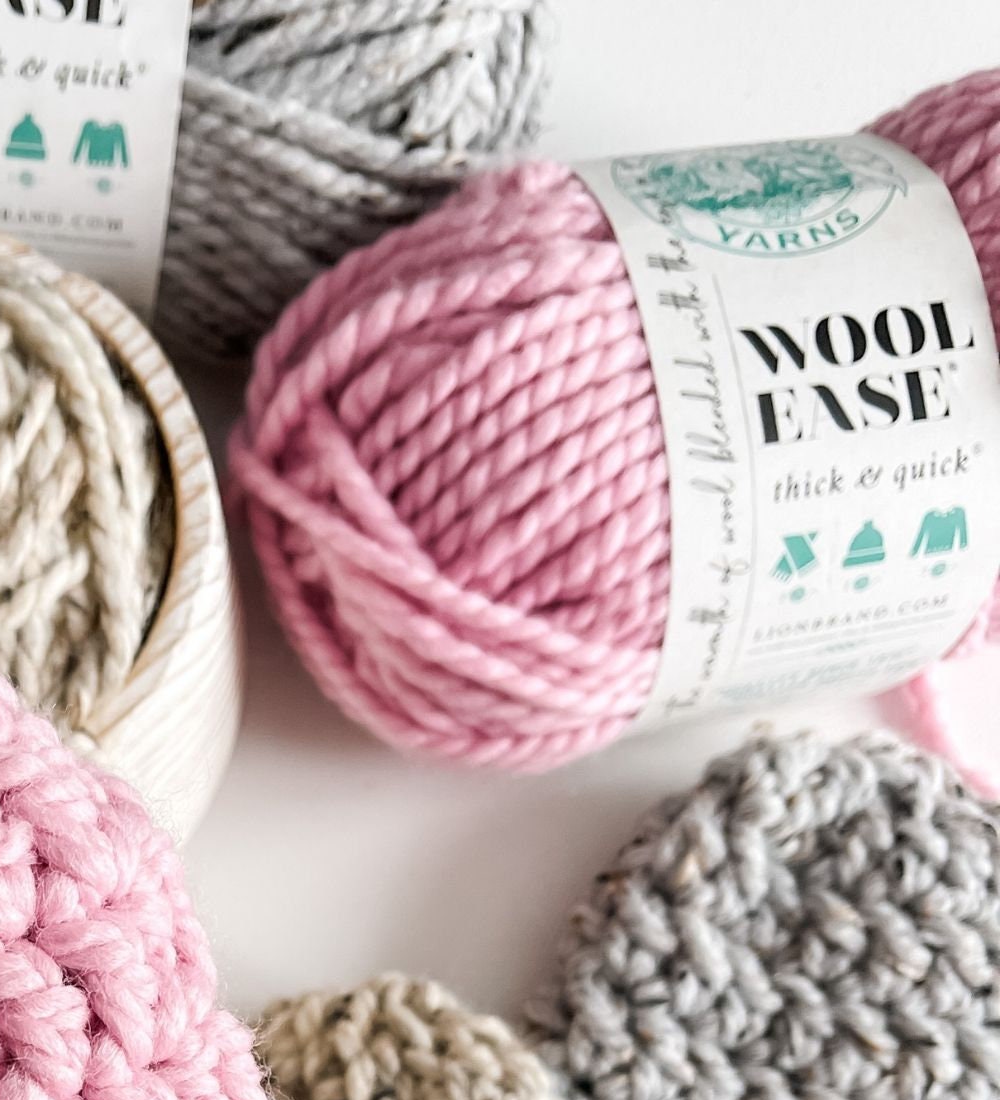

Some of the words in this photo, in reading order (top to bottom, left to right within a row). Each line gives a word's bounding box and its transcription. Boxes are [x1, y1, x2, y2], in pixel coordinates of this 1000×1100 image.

[17, 55, 46, 79] &
[717, 206, 861, 251] YARNS
[648, 237, 698, 272] the
[657, 279, 712, 343] with
[739, 301, 975, 375] WOOL
[674, 349, 738, 464] blended
[774, 465, 845, 503] thick
[854, 464, 884, 489] &
[689, 474, 737, 545] wool
[708, 554, 750, 585] of
